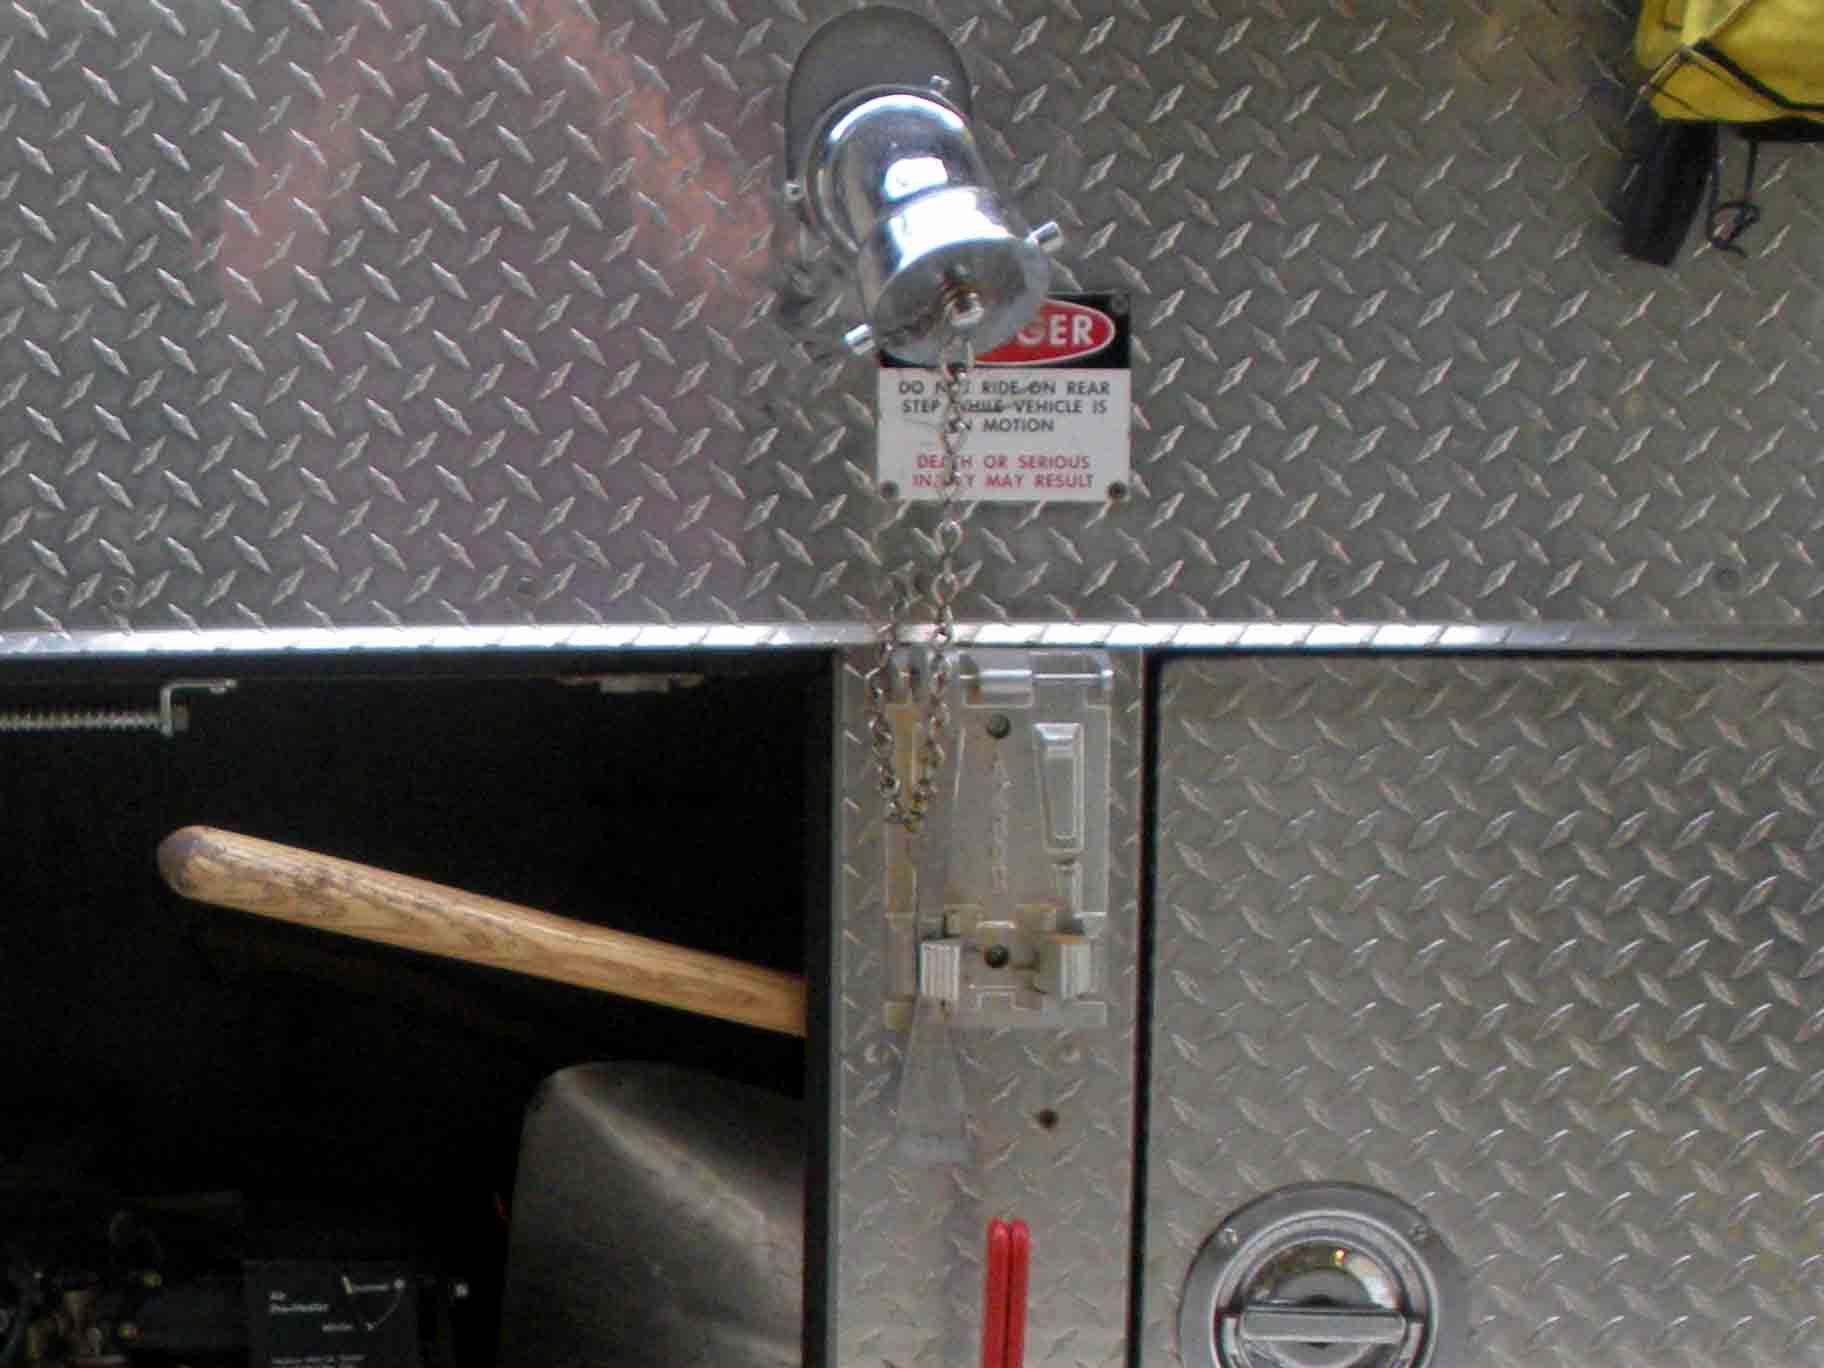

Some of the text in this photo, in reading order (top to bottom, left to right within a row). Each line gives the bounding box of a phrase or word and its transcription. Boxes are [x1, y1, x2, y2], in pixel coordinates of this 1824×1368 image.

[898, 381, 1110, 395] DO NT RIDE ON REAR
[902, 399, 1107, 413] STEP HILE VEHICLE IS
[983, 418, 1055, 432] MOTION
[916, 454, 1091, 468] DEAH OR SERIOUS
[984, 473, 1024, 488] MAY
[1033, 473, 1094, 488] RESULT
